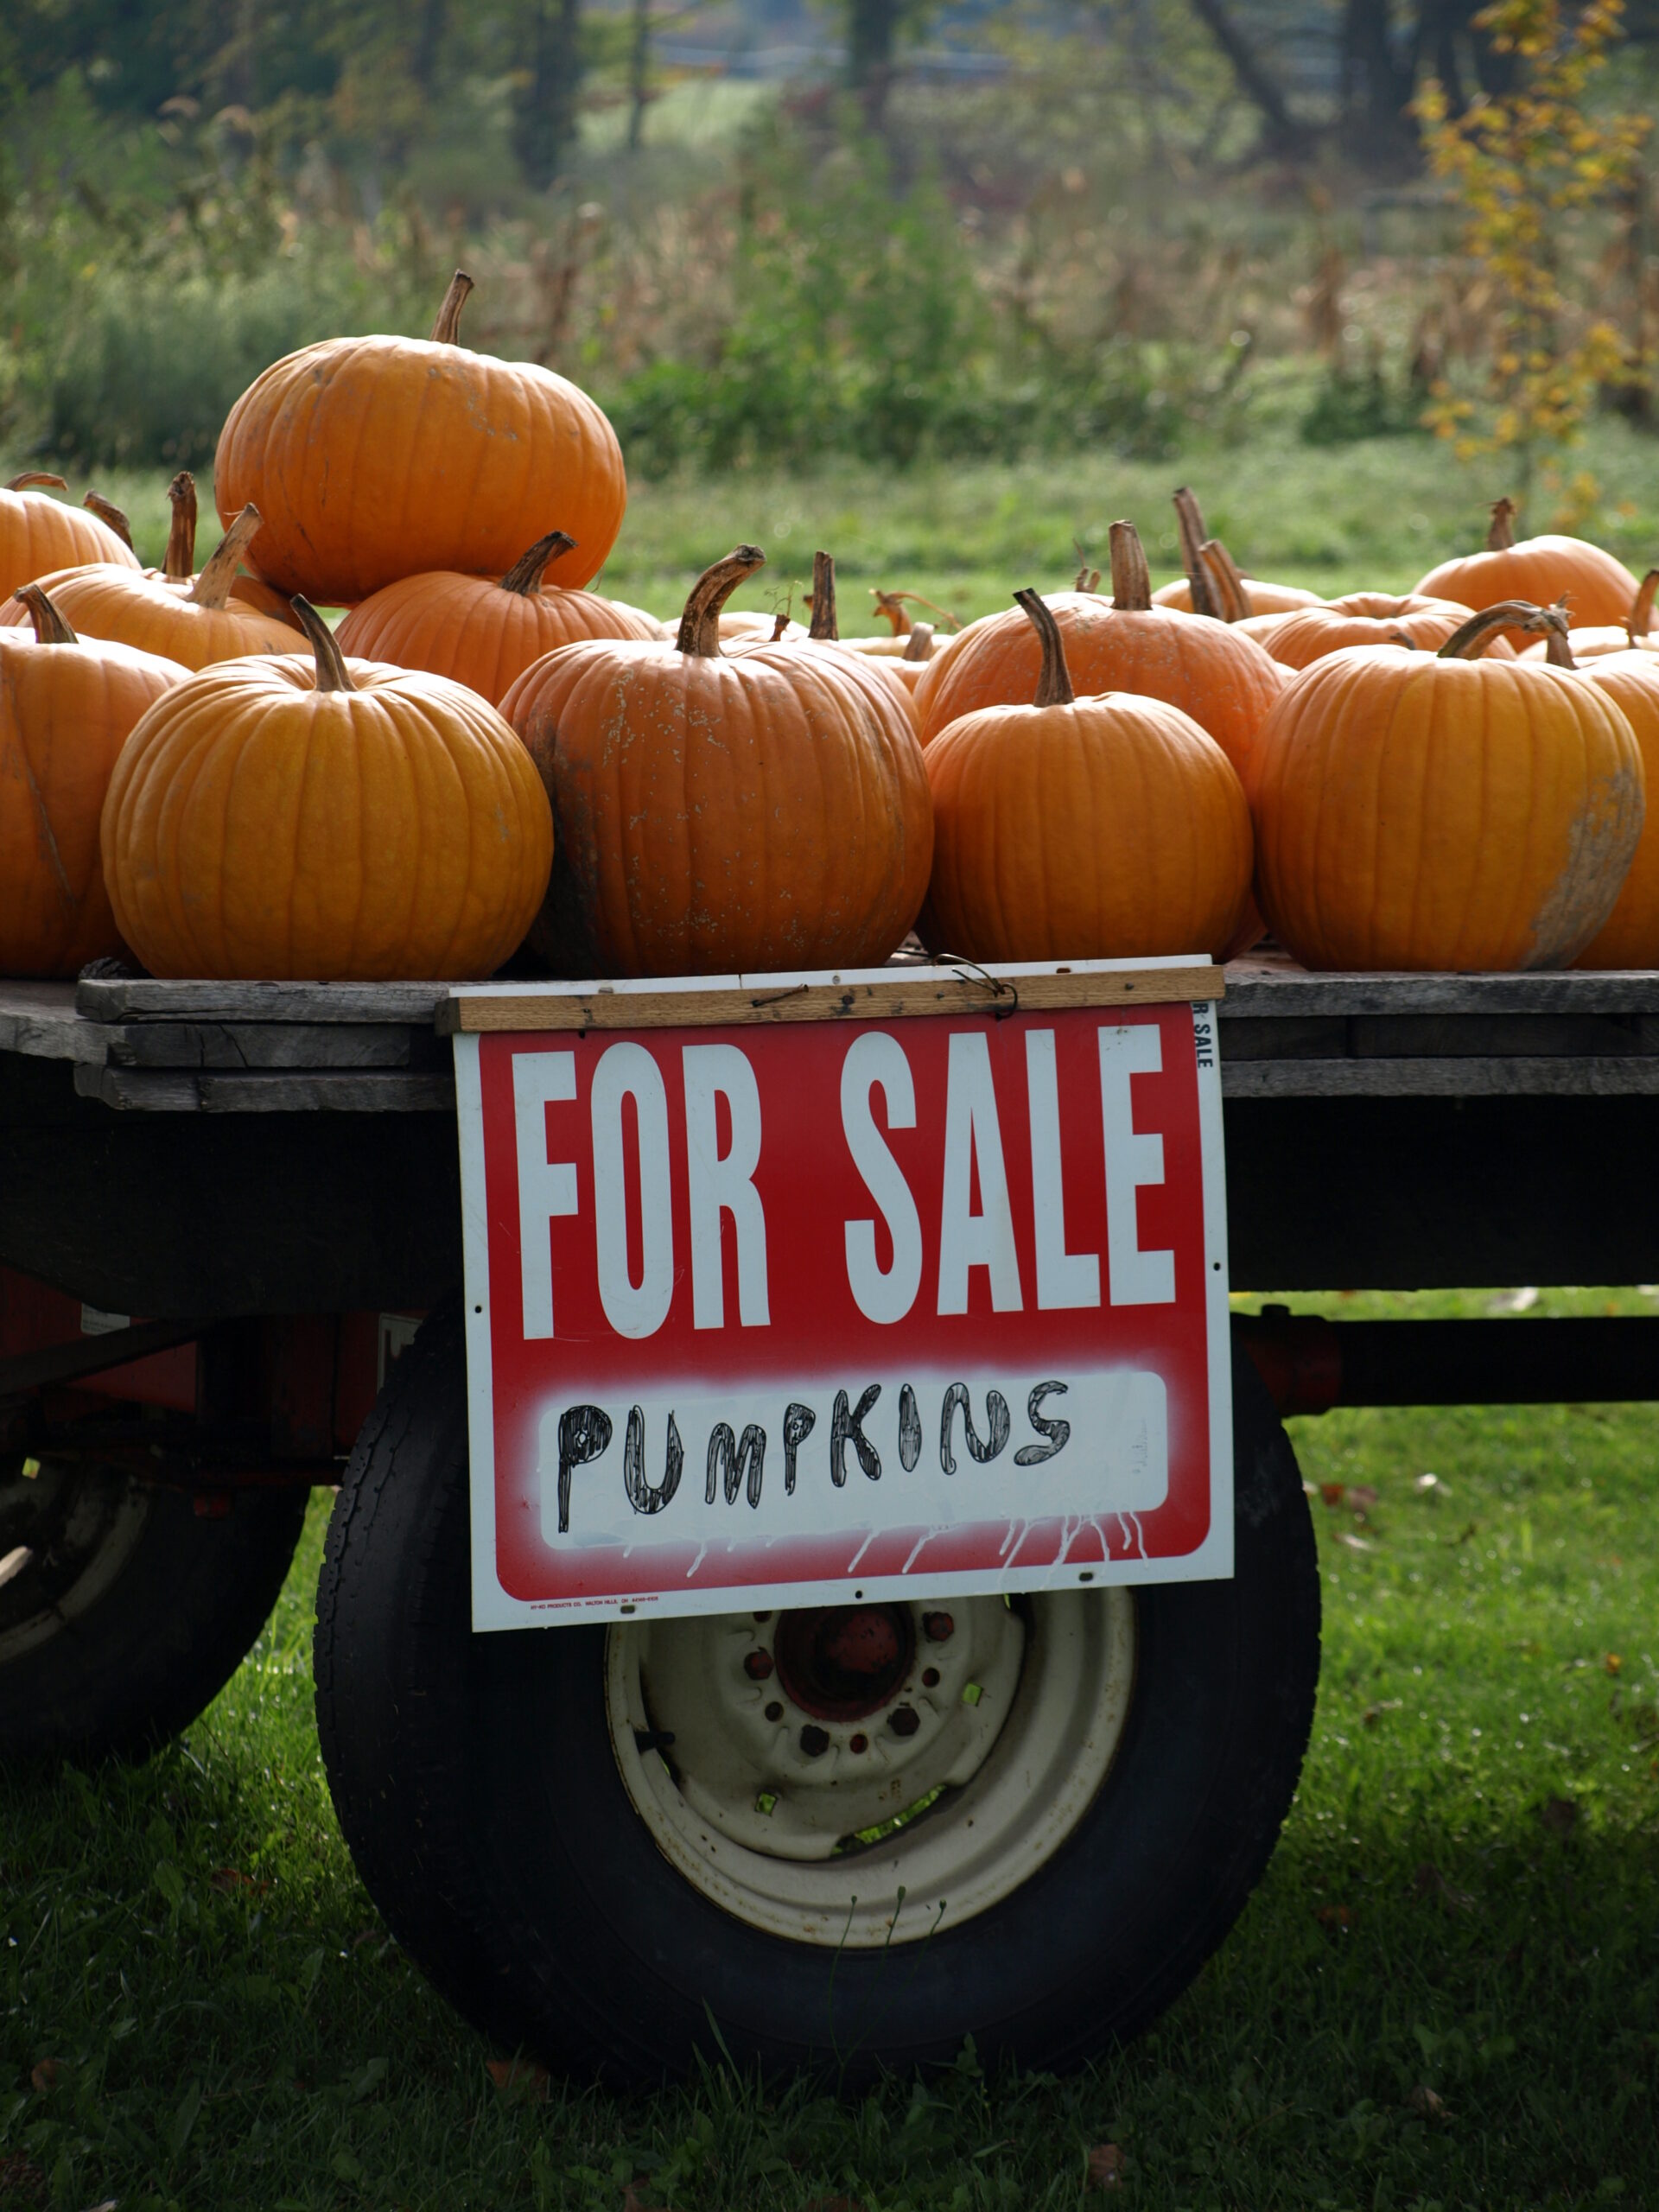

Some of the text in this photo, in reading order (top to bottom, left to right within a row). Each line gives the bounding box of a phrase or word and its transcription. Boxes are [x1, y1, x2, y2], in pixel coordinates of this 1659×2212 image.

[1193, 1024, 1213, 1069] SALE
[512, 1024, 1176, 1340] FOR SALE
[558, 1382, 1072, 1535] PUMPKINS
